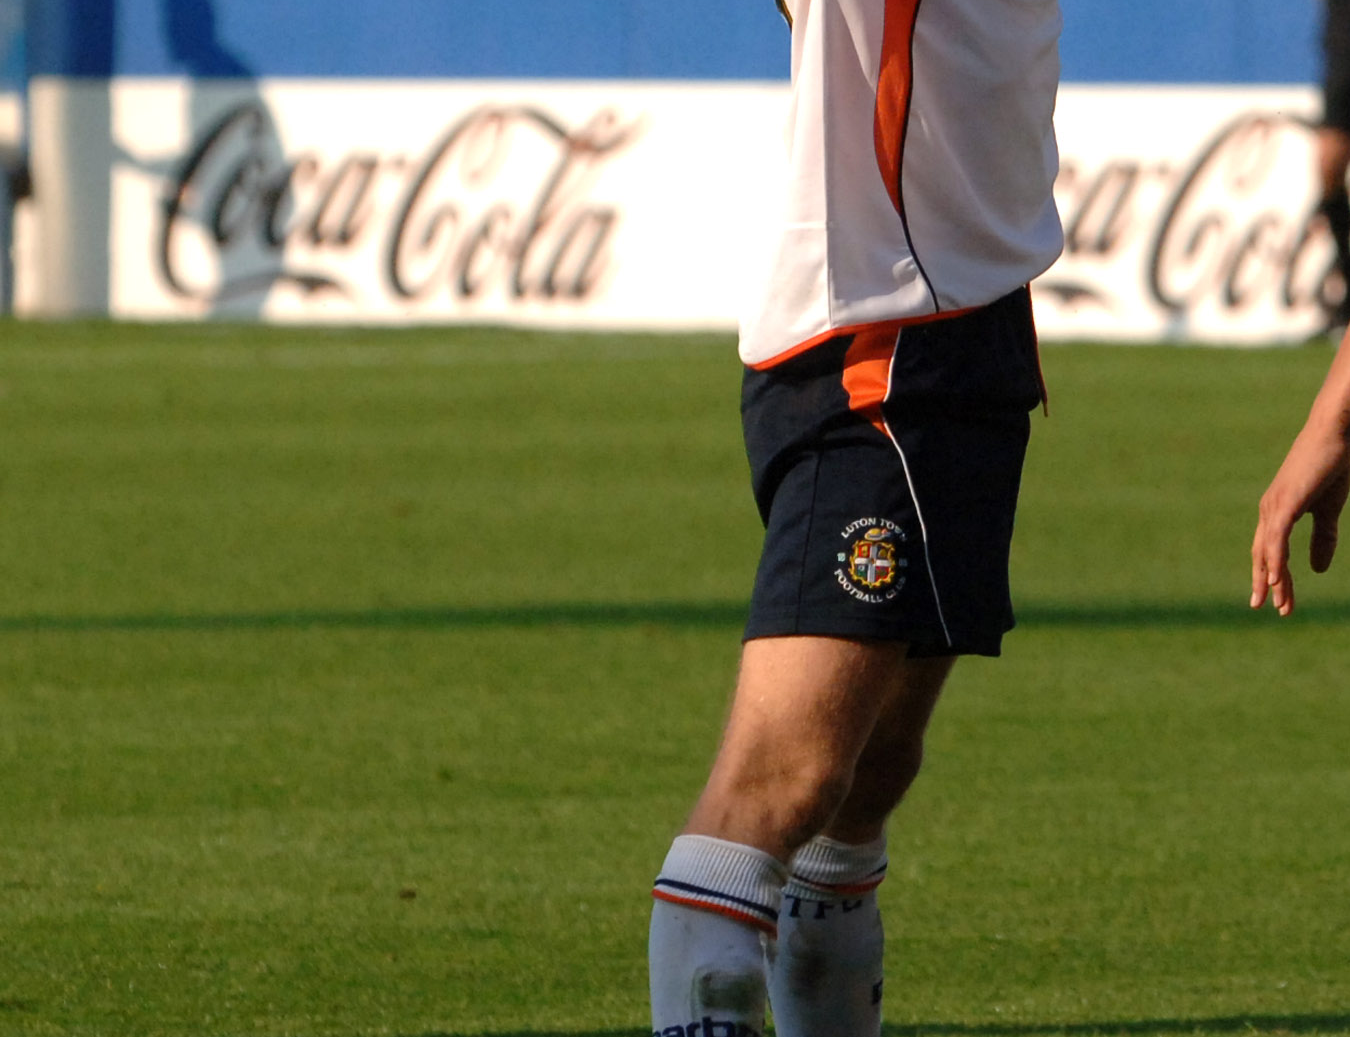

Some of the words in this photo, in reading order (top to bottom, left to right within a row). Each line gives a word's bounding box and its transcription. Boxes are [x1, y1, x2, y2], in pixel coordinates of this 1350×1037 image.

[153, 102, 648, 308] Coca-Cola
[840, 517, 877, 539] LUTON
[834, 568, 883, 603] FOOTBALL
